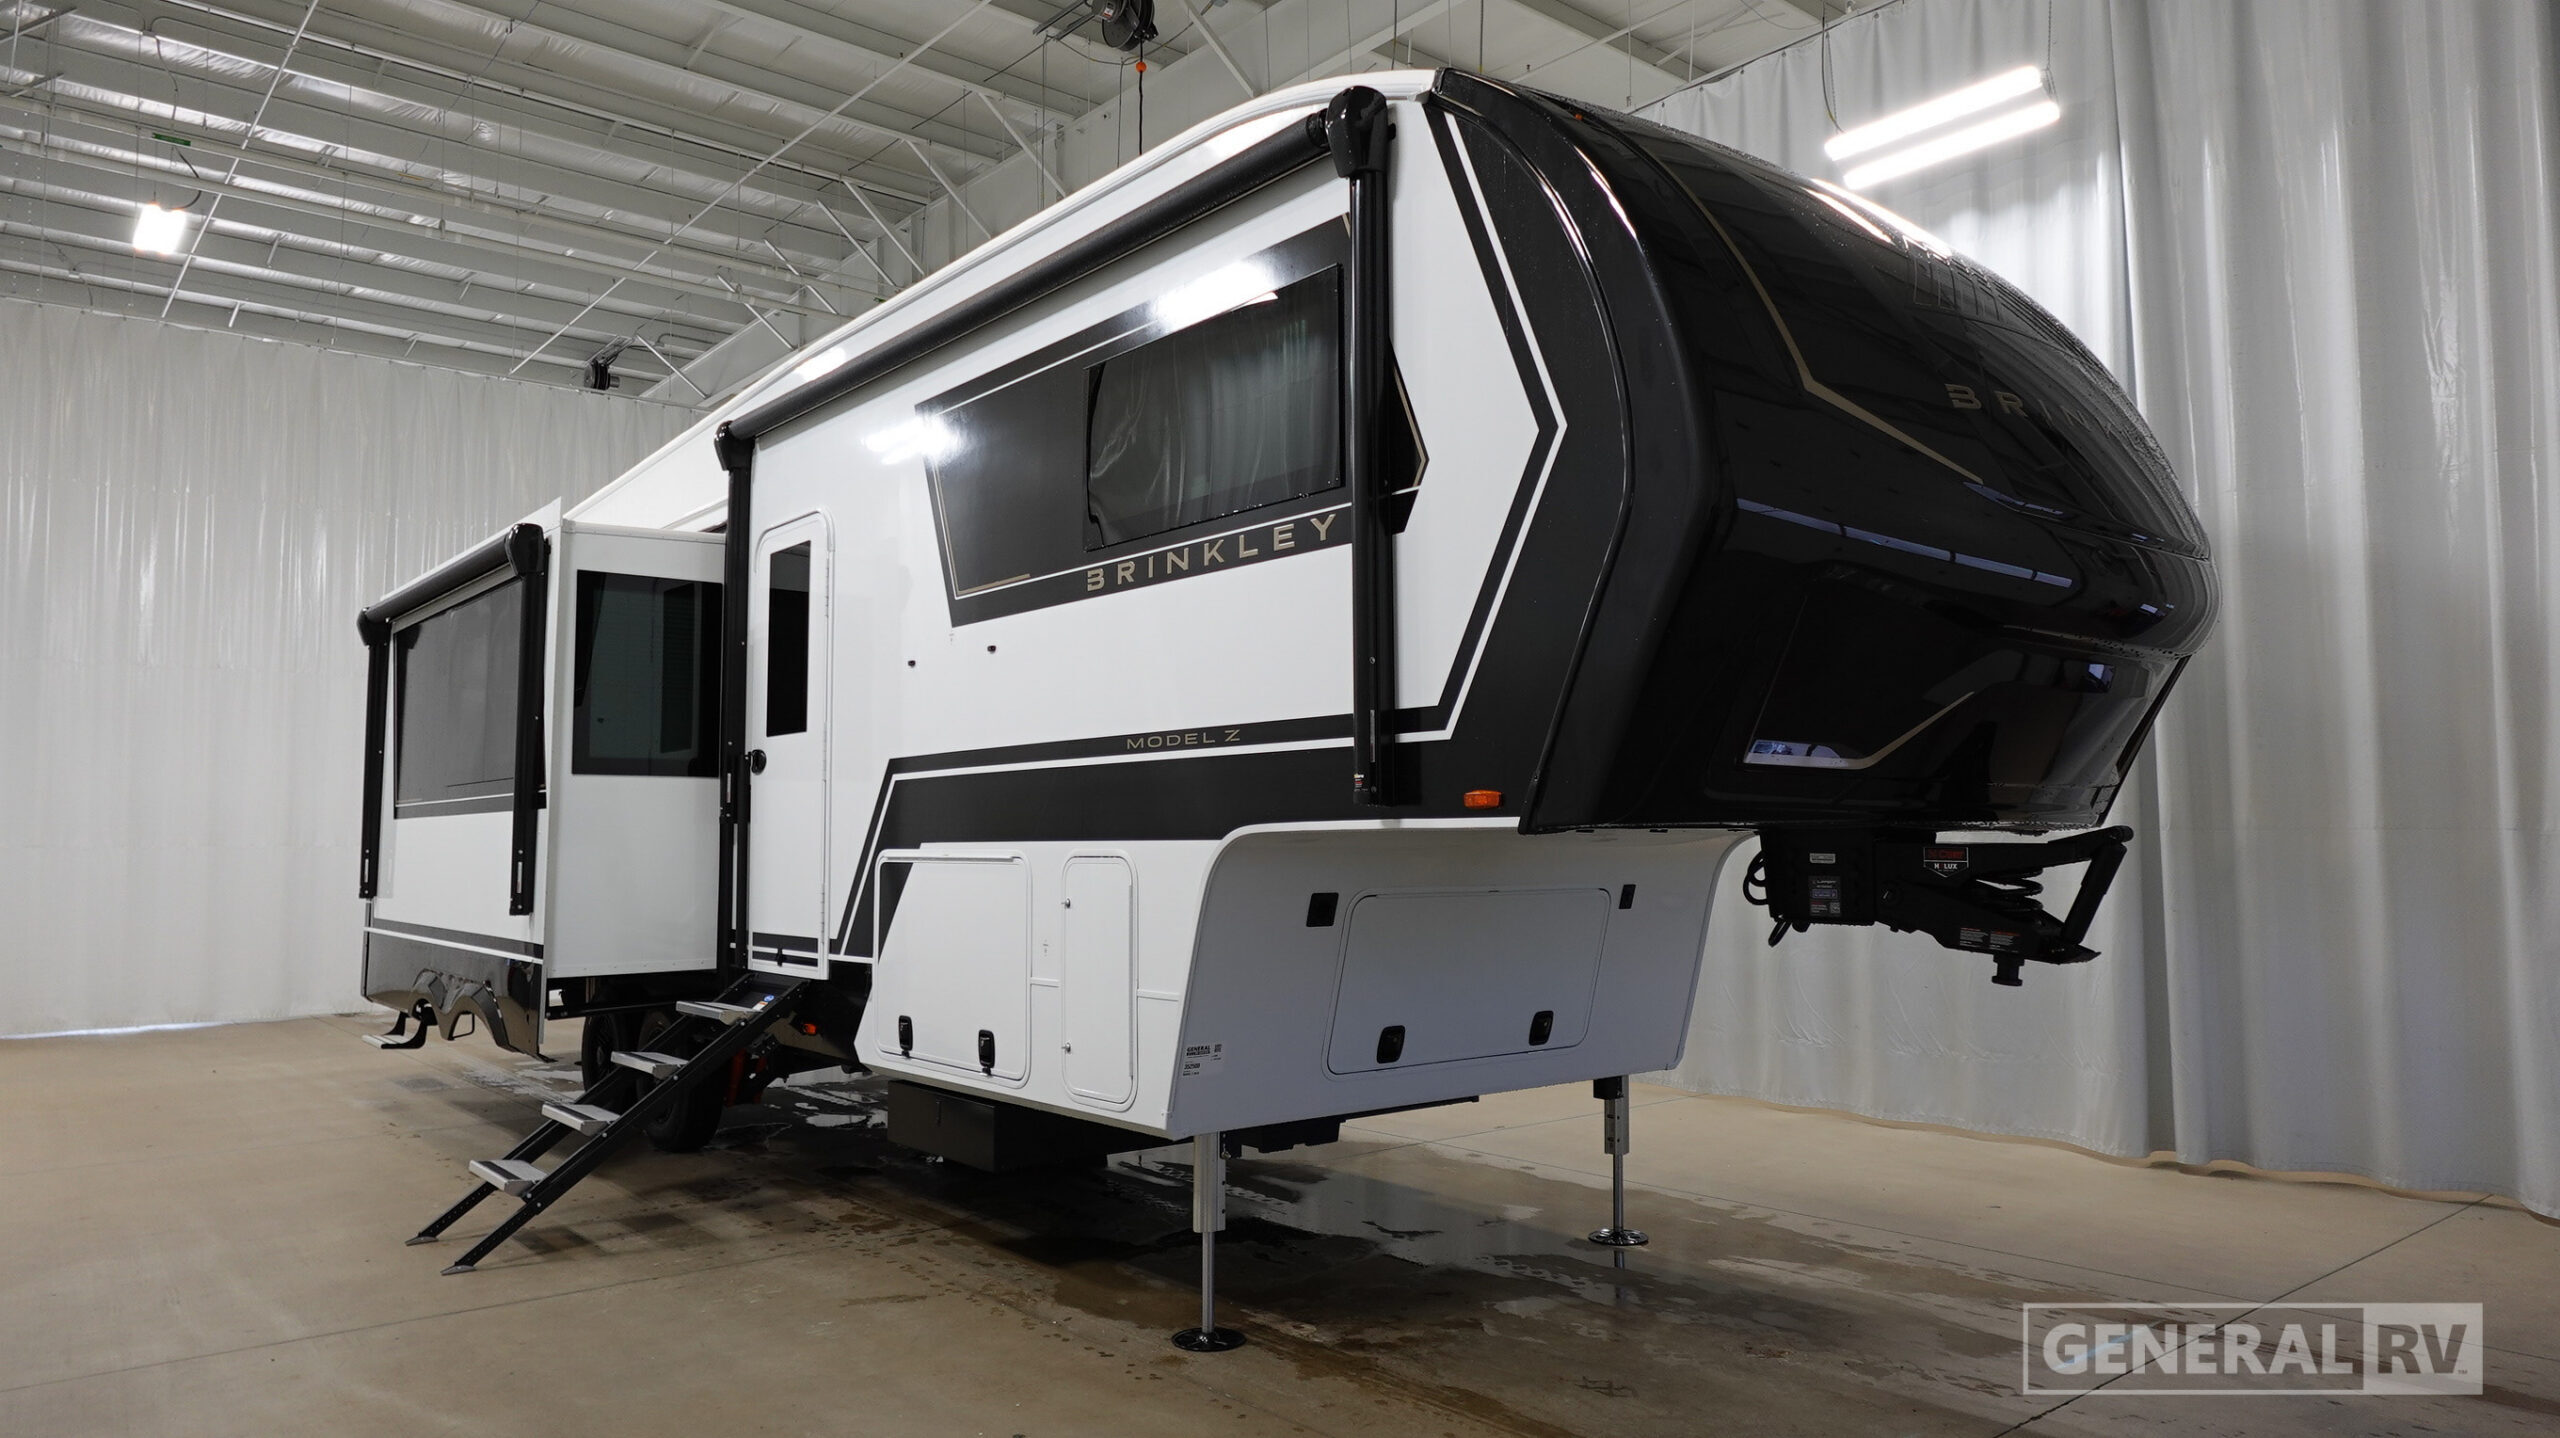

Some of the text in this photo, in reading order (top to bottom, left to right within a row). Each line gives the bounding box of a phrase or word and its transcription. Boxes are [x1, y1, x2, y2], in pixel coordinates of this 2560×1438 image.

[1086, 513, 1337, 592] BRINKLEY
[1126, 728, 1241, 750] MODEL Z
